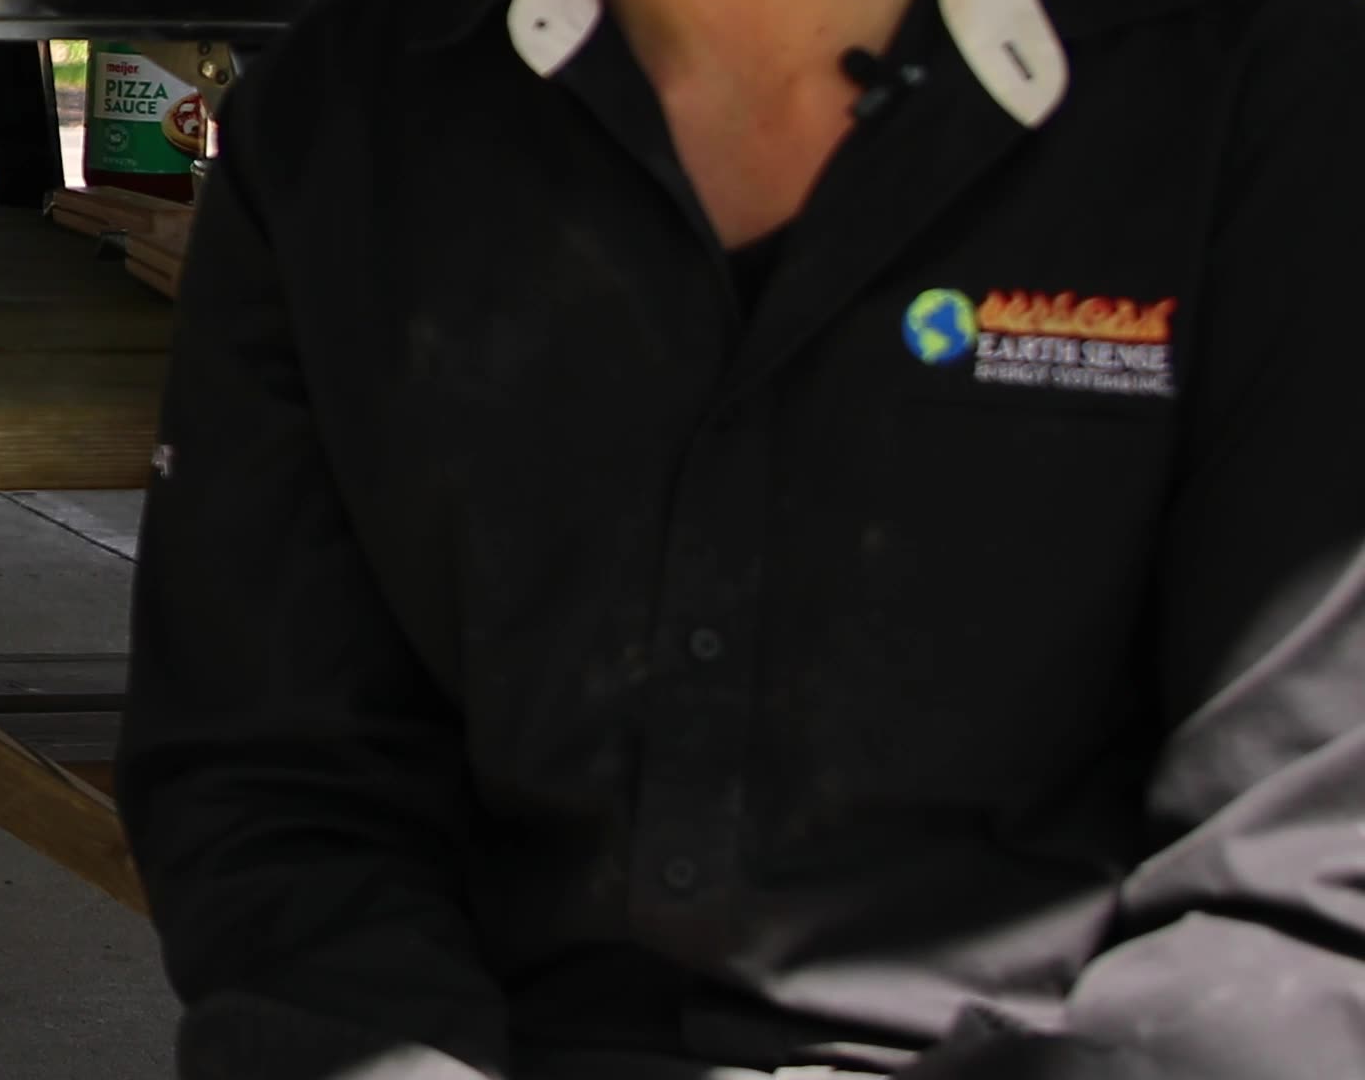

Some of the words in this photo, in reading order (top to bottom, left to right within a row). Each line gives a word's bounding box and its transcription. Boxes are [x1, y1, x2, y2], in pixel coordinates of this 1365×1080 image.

[106, 62, 140, 76] meijer
[105, 79, 169, 100] PIZZA
[104, 99, 157, 115] SAUCE
